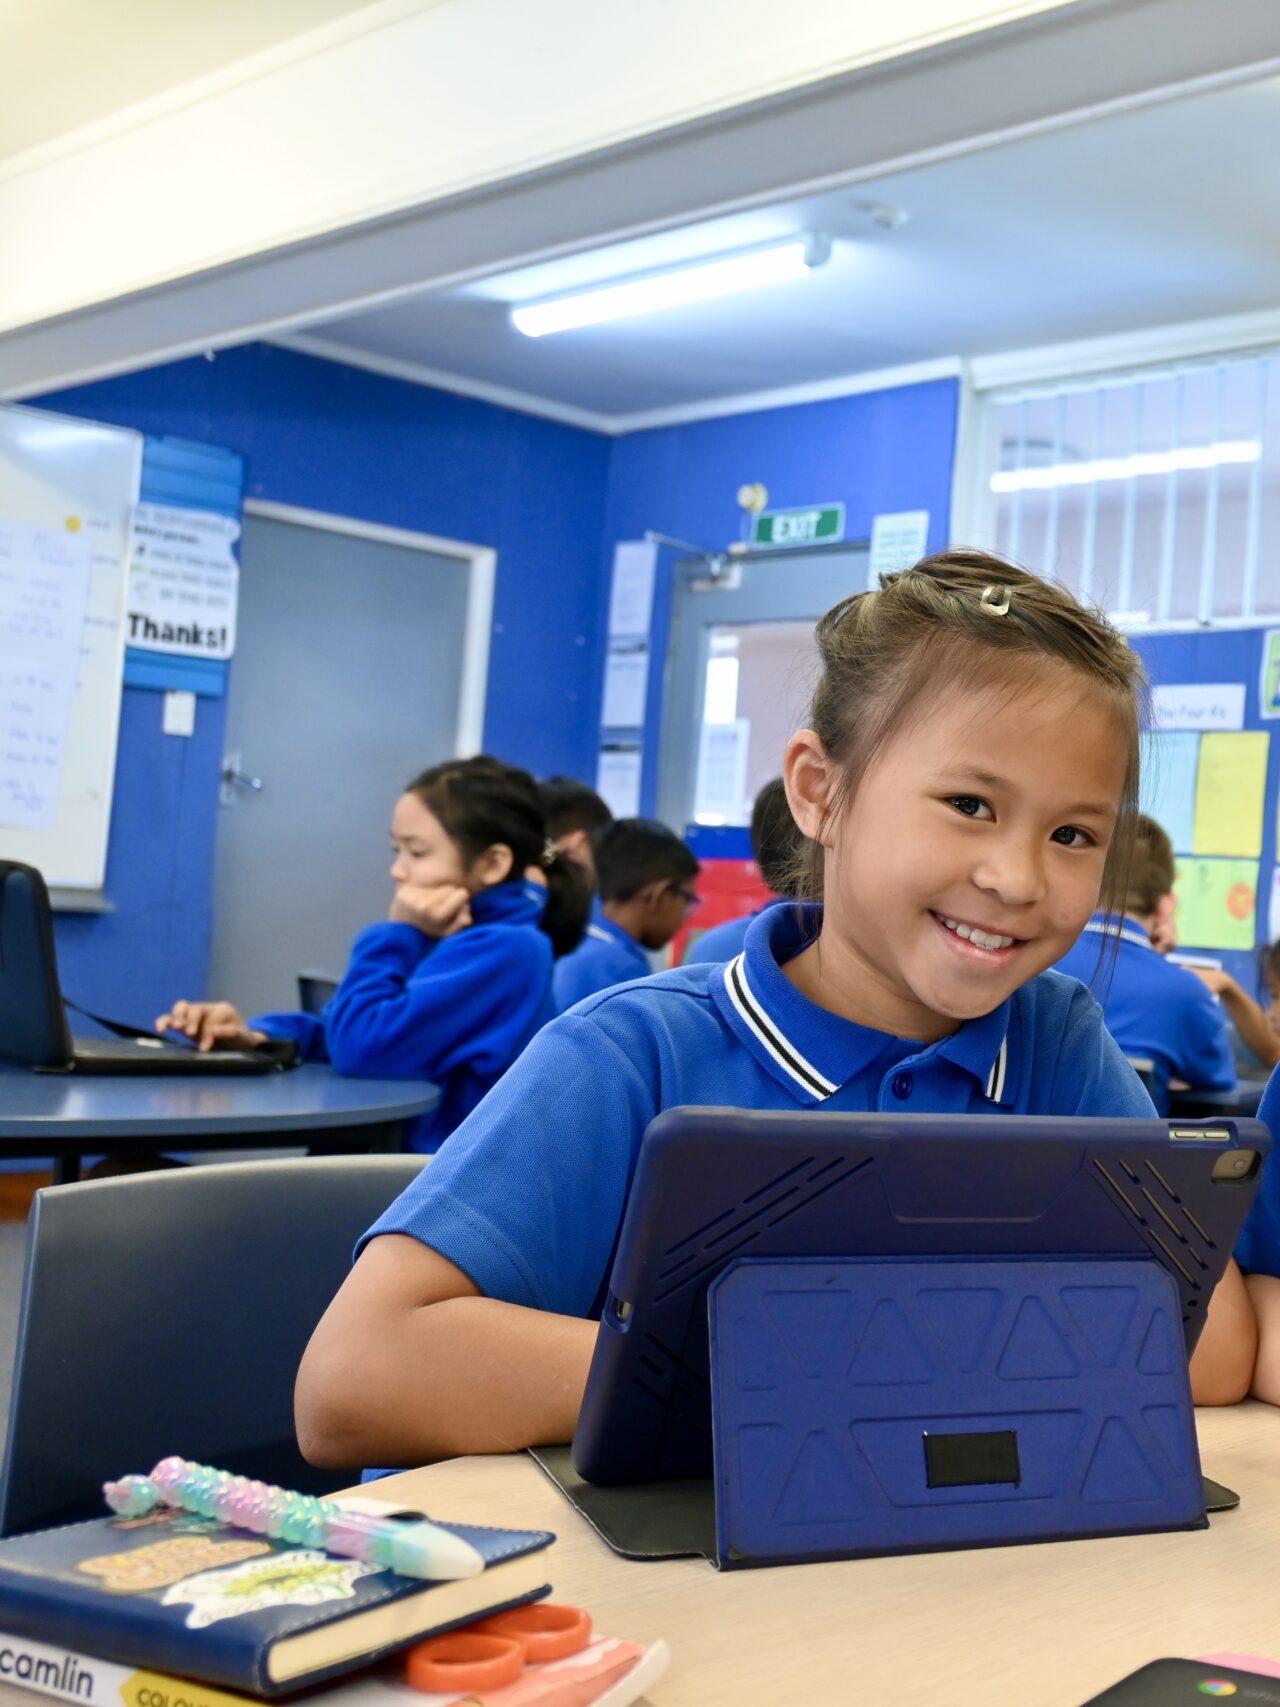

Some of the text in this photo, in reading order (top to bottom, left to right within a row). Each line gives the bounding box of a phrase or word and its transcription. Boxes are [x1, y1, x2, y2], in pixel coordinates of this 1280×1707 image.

[773, 511, 821, 544] EXIT
[128, 613, 227, 649] Thanks!
[0, 1649, 94, 1699] camlin
